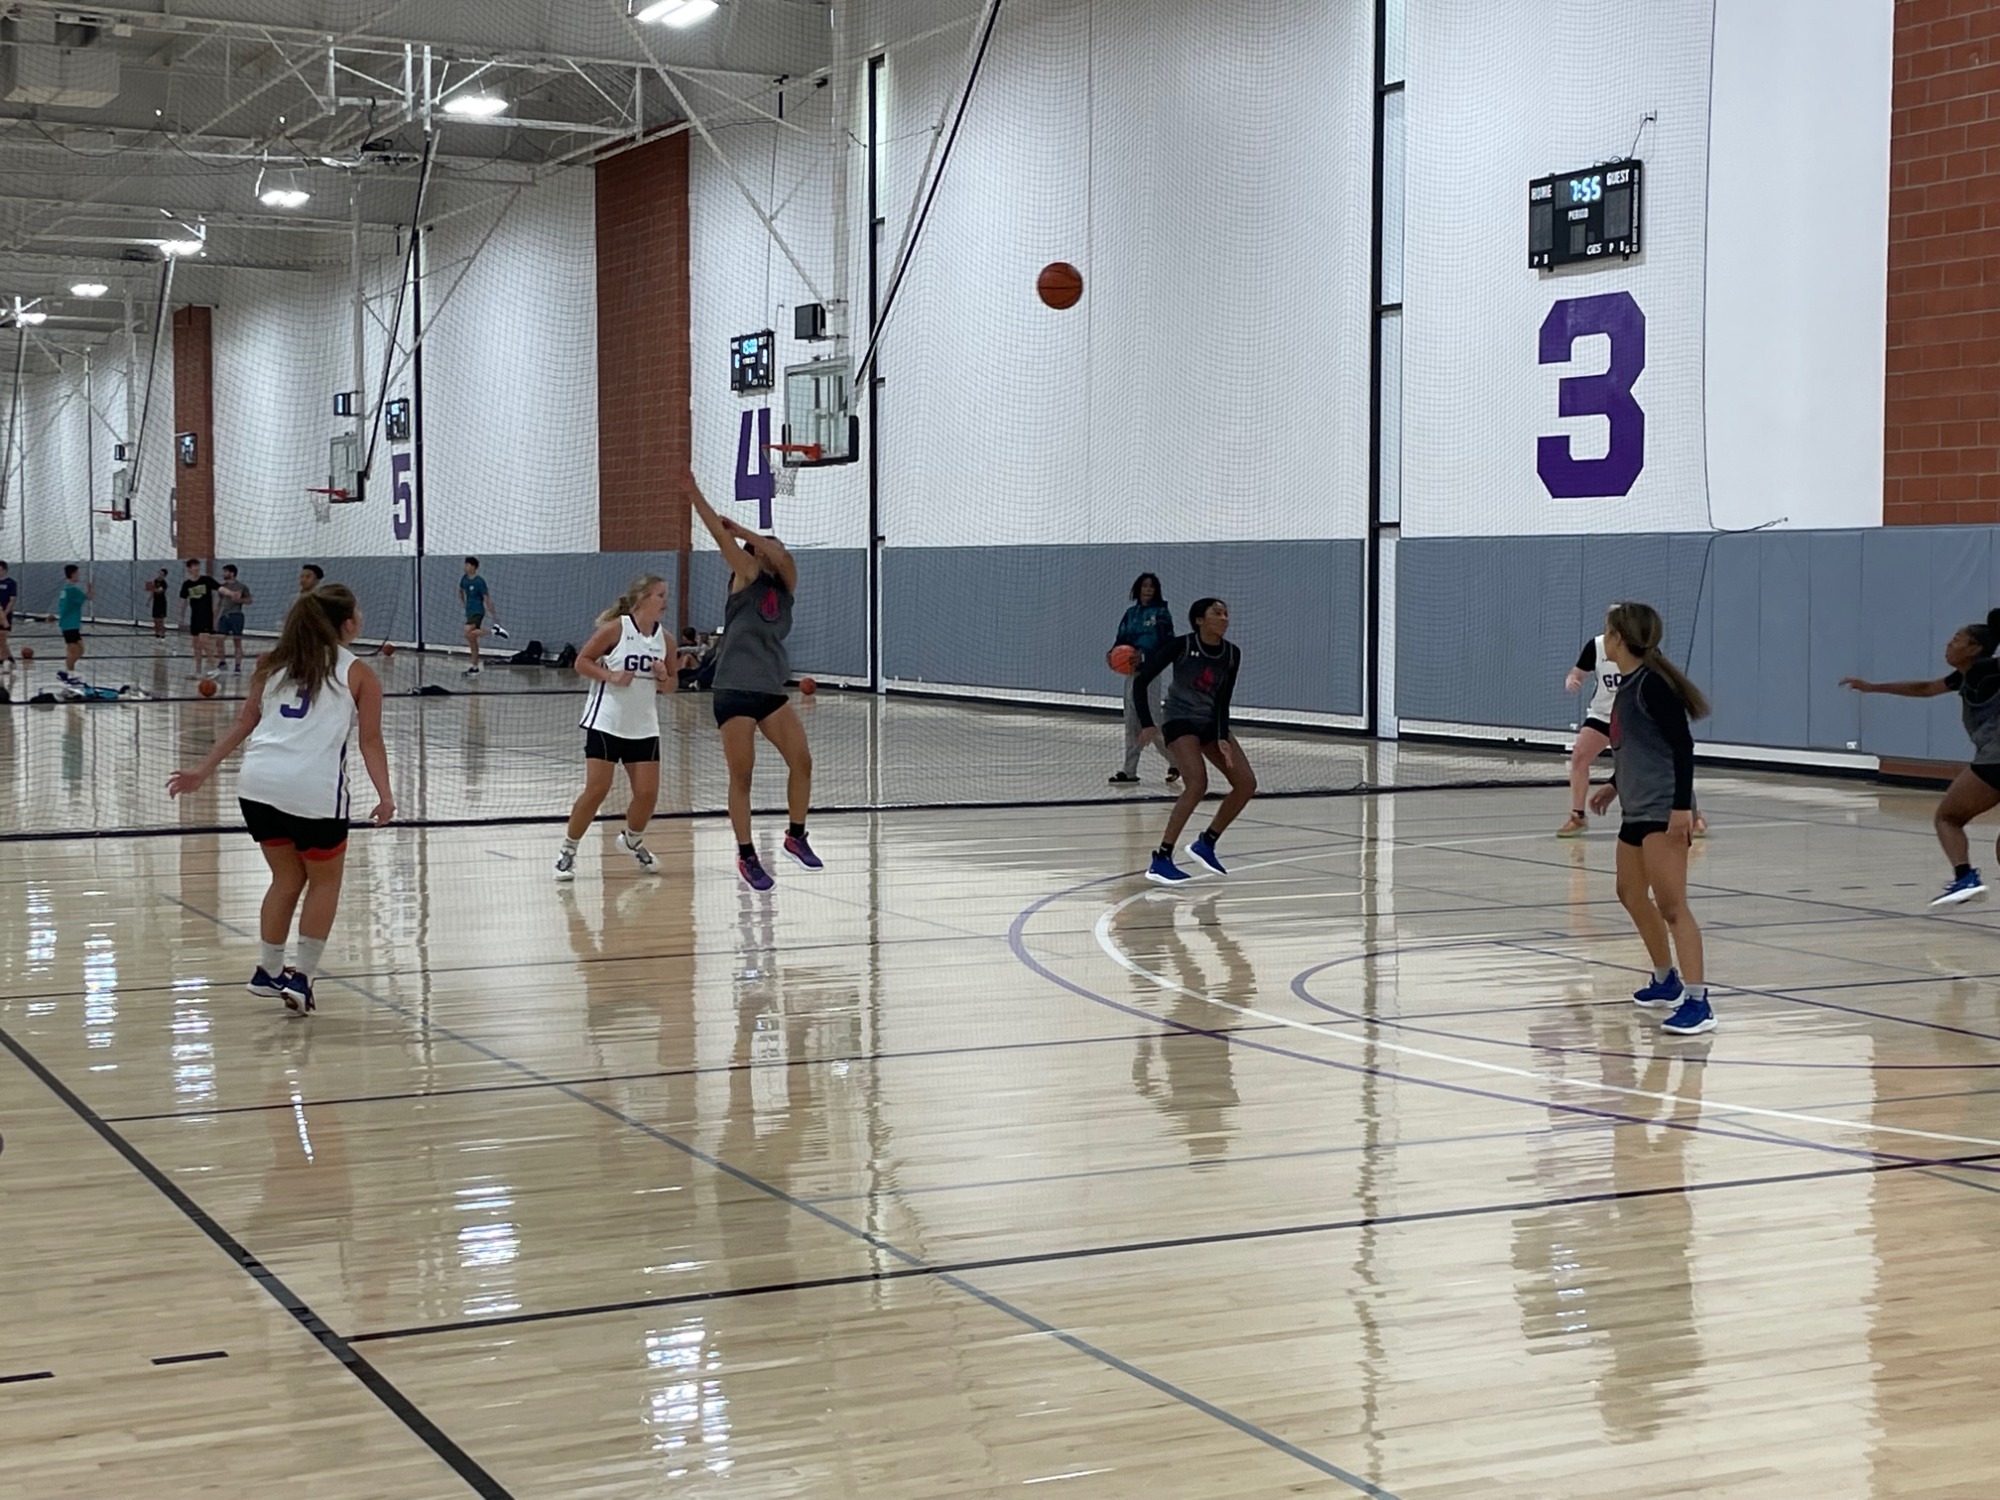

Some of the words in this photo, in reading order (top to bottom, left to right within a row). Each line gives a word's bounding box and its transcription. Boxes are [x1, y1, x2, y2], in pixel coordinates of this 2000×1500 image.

[1570, 175, 1601, 202] 7:55
[1537, 291, 1646, 499] 3
[392, 453, 412, 541] 5
[735, 408, 776, 529] 4
